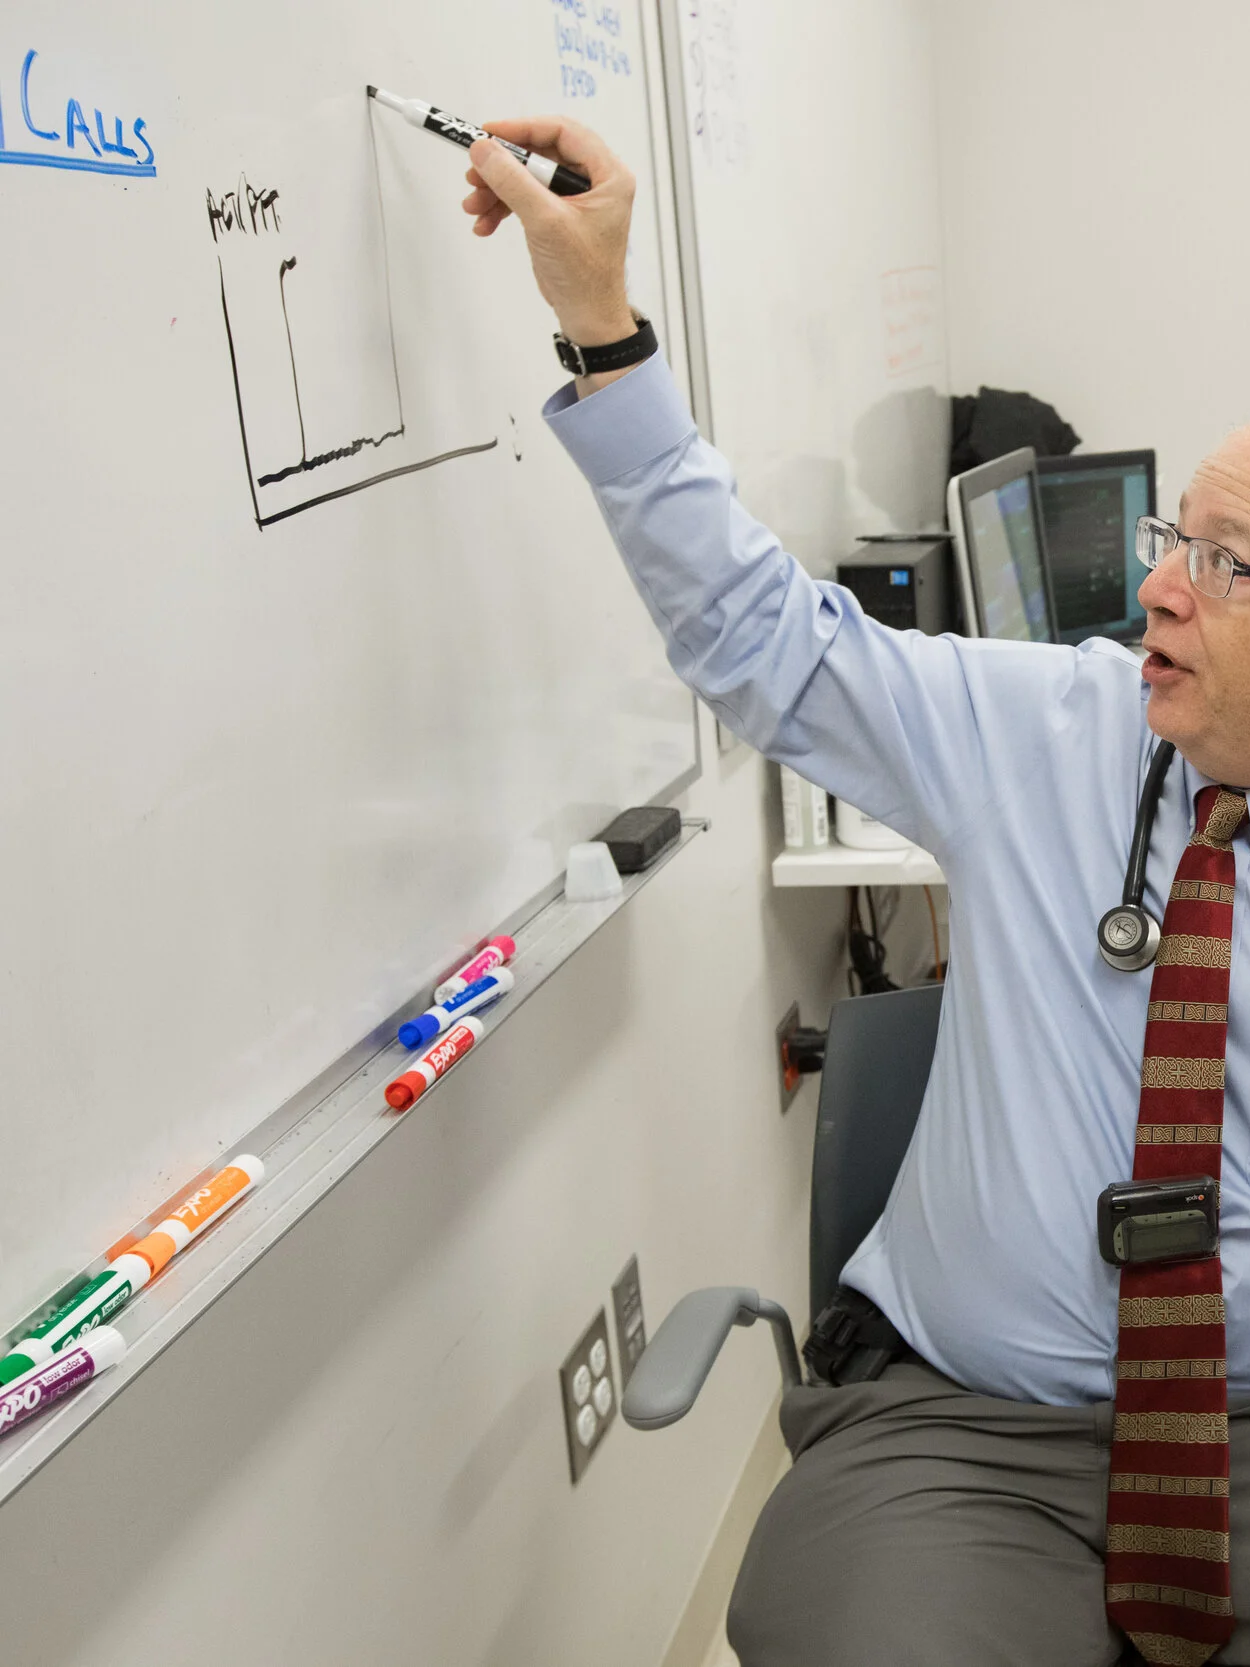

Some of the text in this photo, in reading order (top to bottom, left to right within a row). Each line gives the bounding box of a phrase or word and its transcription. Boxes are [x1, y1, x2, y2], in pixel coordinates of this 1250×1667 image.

[429, 111, 490, 141] EXPO
[429, 1041, 457, 1072] EXPO
[171, 1188, 212, 1218] EXPO
[43, 1356, 82, 1384] low odor
[69, 1369, 91, 1387] chisel
